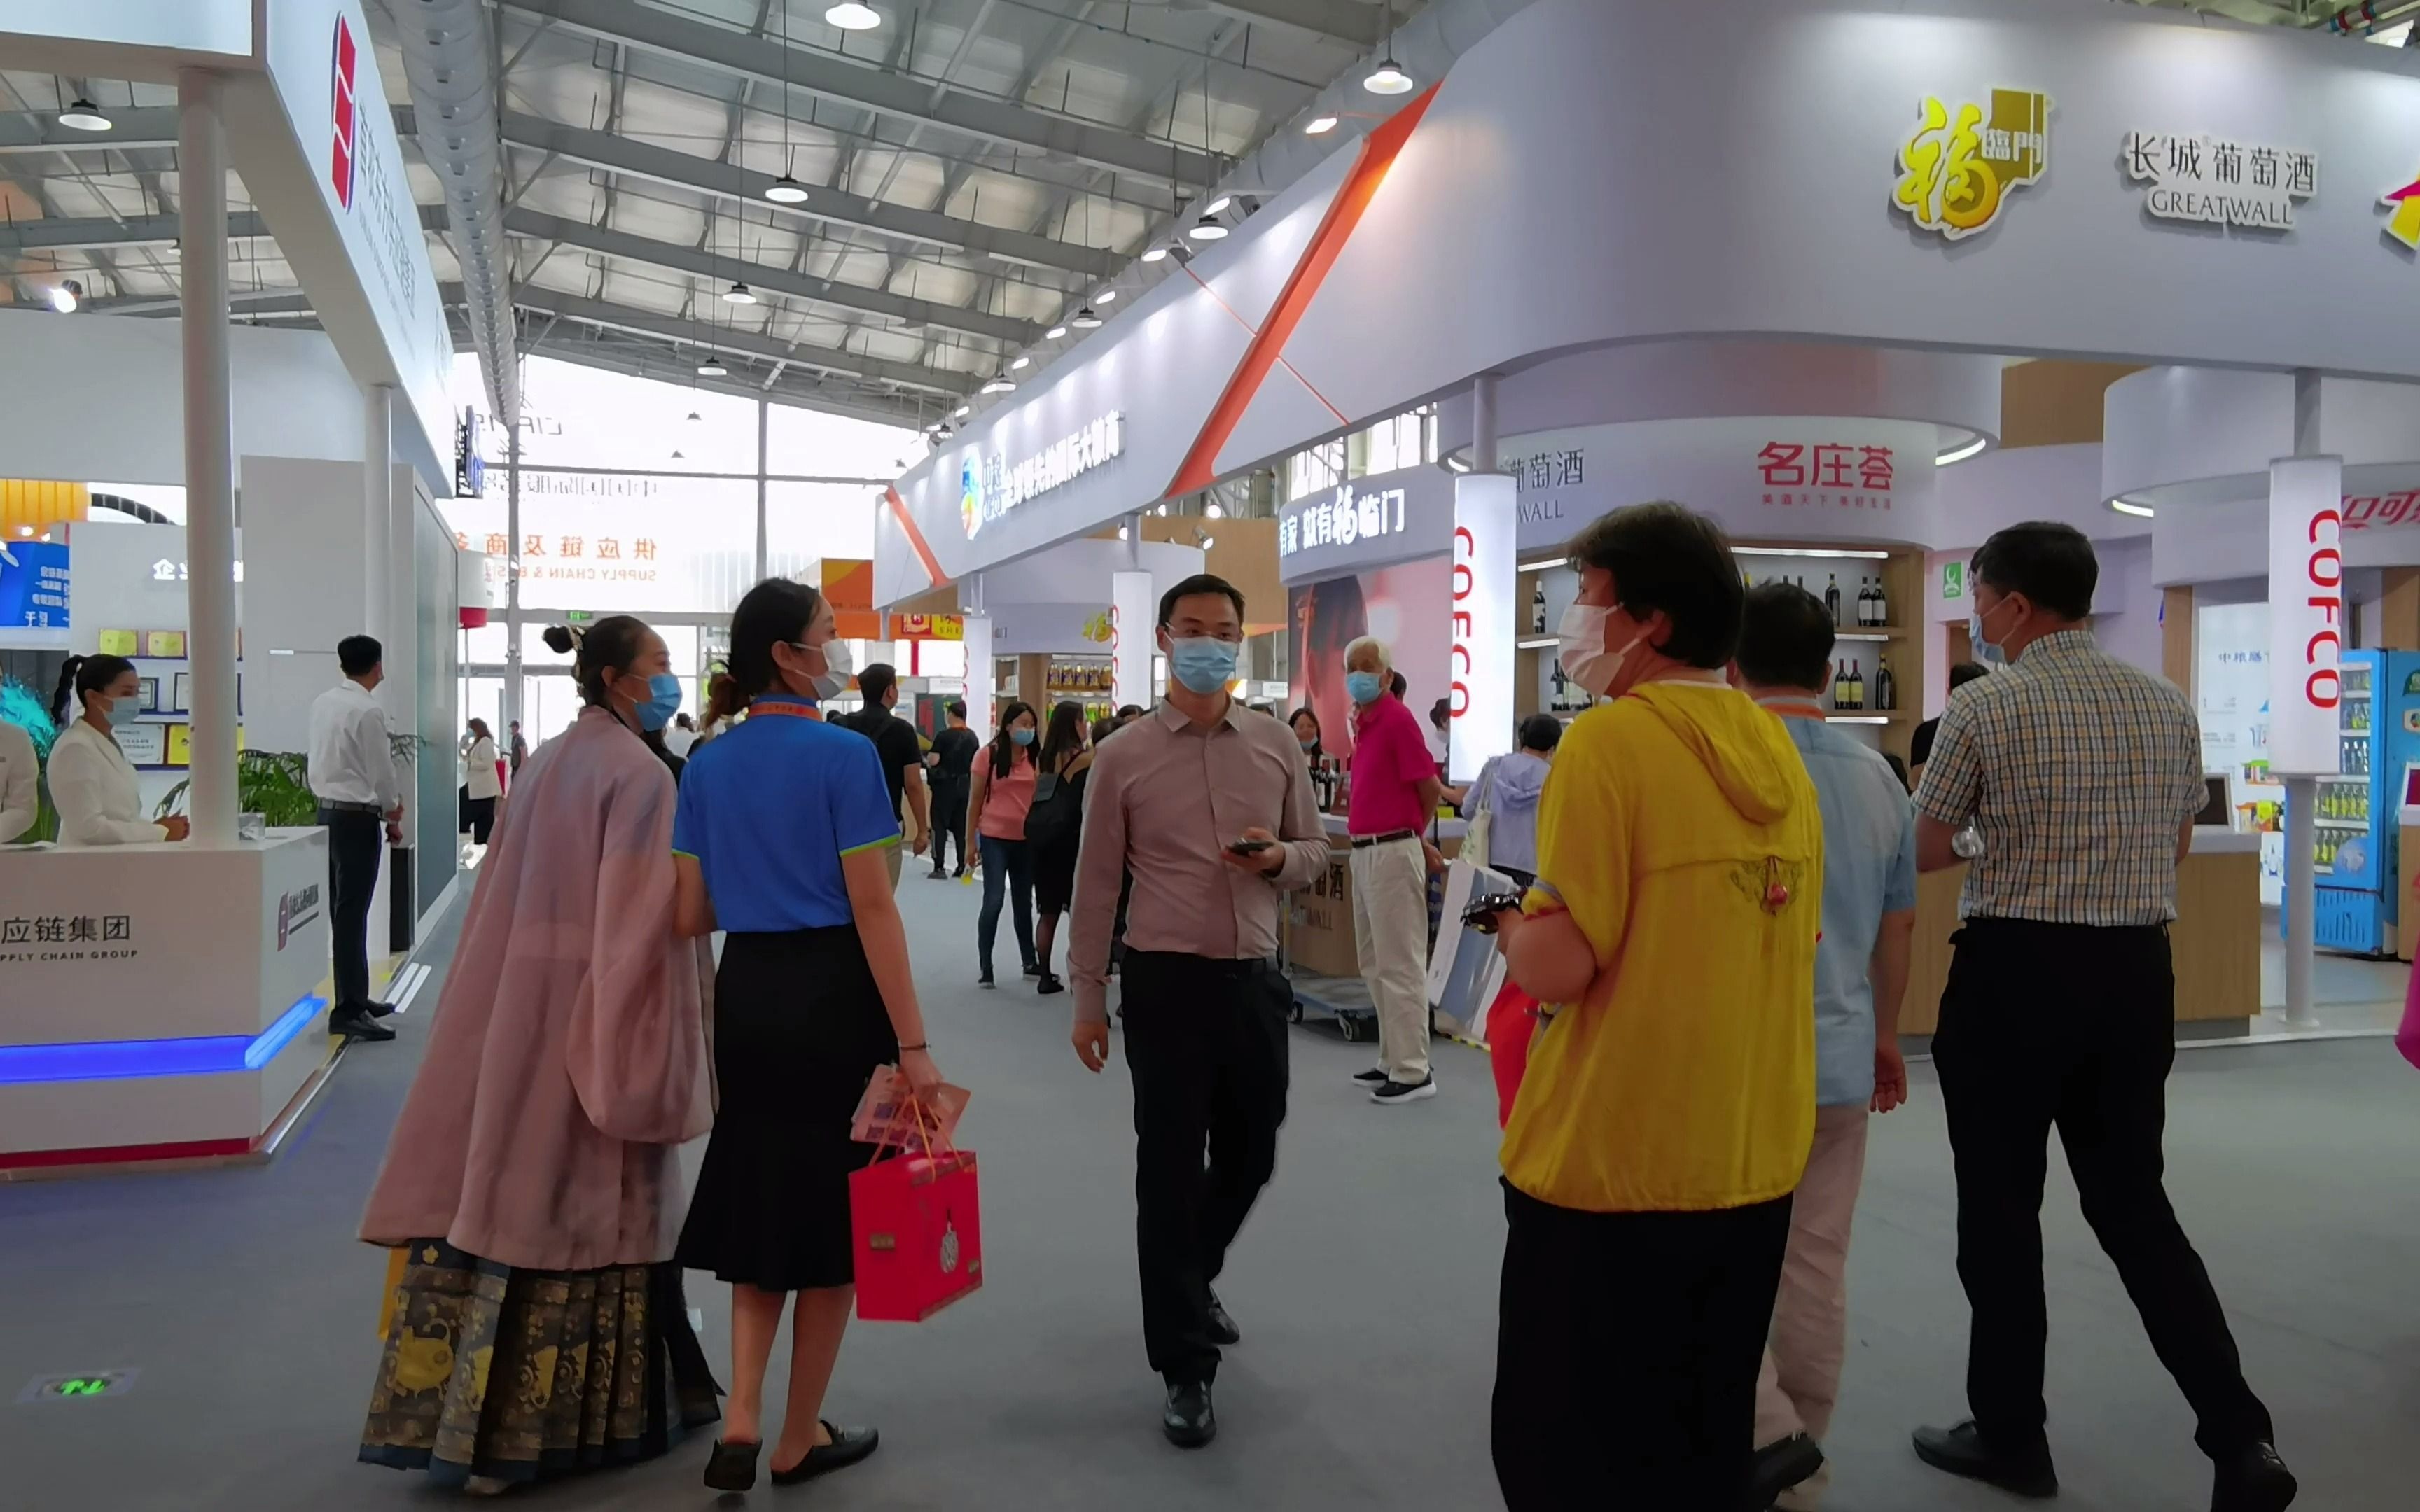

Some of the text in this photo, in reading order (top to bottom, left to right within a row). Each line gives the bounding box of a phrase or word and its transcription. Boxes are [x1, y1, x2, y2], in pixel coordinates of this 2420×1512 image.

[2129, 132, 2315, 192] 长城葡萄酒
[2151, 190, 2293, 224] GREATWALL
[1758, 442, 1893, 490] 名庄荟
[2306, 510, 2342, 708] COFCO
[1, 916, 130, 944] 应链集团
[40, 951, 84, 961] CHAIN
[90, 949, 138, 959] GROUP
